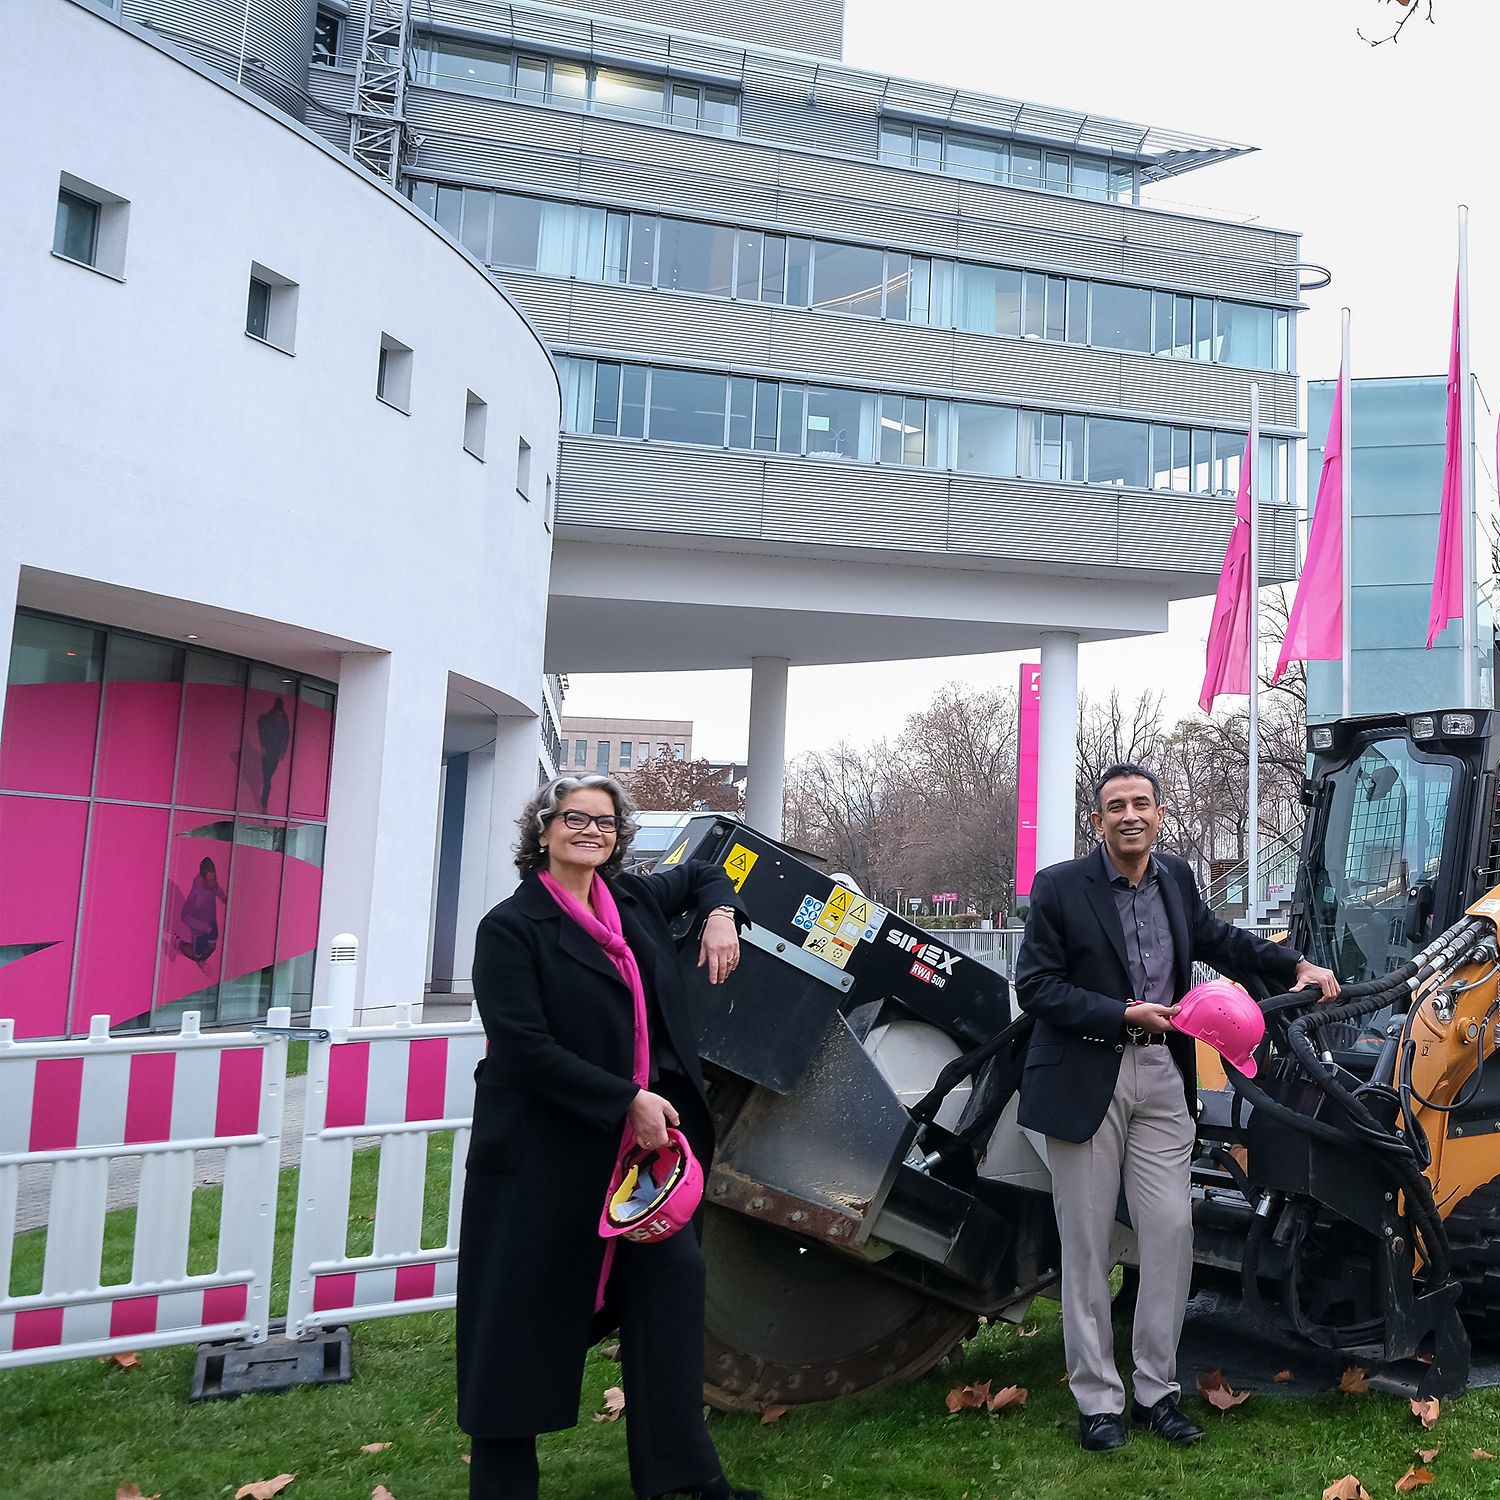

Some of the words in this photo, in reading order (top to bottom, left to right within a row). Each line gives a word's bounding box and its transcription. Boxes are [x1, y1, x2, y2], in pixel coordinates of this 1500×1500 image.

[886, 929, 963, 976] SIMEX
[911, 963, 932, 981] RWA
[930, 974, 946, 988] 500
